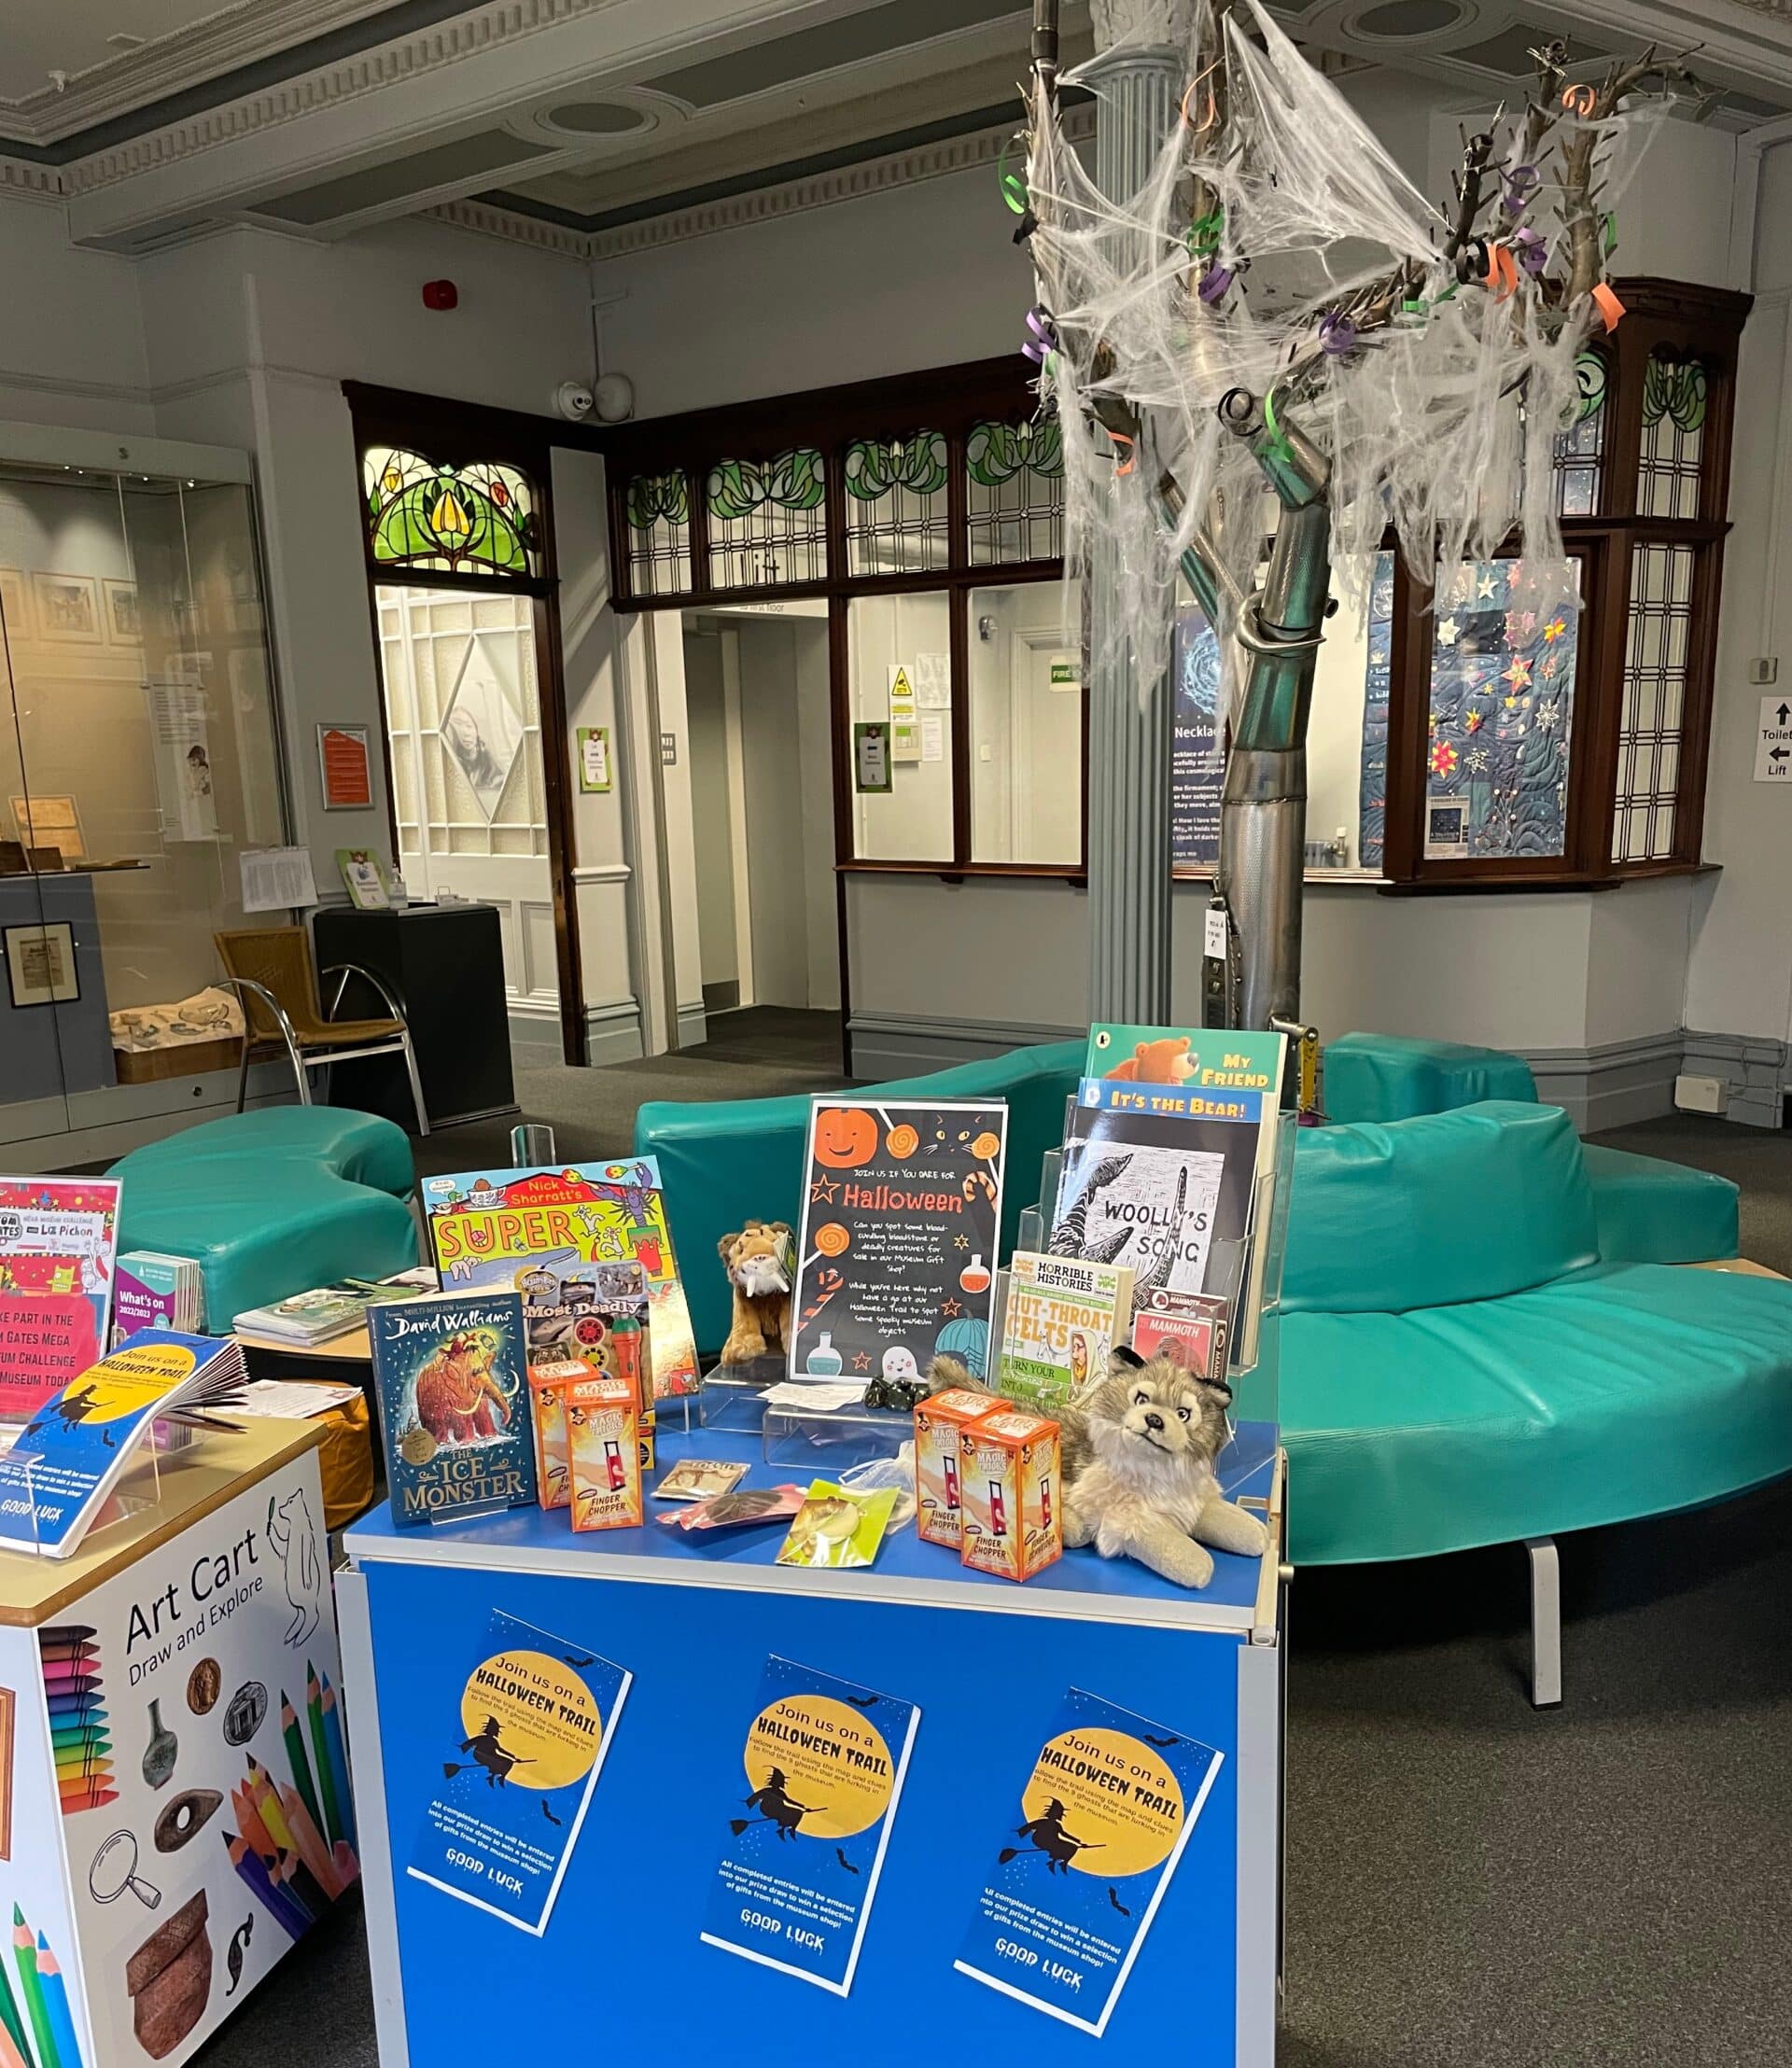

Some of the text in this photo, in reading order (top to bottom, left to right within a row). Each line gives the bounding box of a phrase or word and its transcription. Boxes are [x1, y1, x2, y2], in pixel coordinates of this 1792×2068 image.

[1052, 670, 1071, 678] FIRE
[1768, 764, 1786, 776] Lift
[1201, 1069, 1268, 1088] FRIEND
[1189, 1098, 1246, 1119] BEAR!
[854, 1168, 875, 1177] JOIN
[919, 1170, 939, 1179] DARE
[941, 1171, 956, 1180] FOR
[528, 1181, 560, 1192] Nick
[511, 1189, 582, 1205] Sharratt's
[844, 1183, 962, 1213] Halloween
[1105, 1200, 1208, 1232] WOOLLY'S
[60, 1224, 93, 1237] Pichon
[439, 1210, 579, 1258] SUPER
[871, 1223, 883, 1231] you
[886, 1223, 901, 1231] spot
[858, 1233, 886, 1244] curdling
[889, 1233, 928, 1241] bloodstone
[861, 1243, 941, 1252] deadly creatures for
[1137, 1236, 1199, 1263] SONG
[895, 1254, 924, 1263] Museum
[926, 1255, 945, 1264] Gift
[1039, 1262, 1093, 1281] HORRIBLE
[848, 1281, 867, 1290] While
[870, 1284, 890, 1292] you're
[913, 1285, 927, 1295] why
[1037, 1272, 1093, 1292] HISTORIES
[119, 1291, 165, 1309] What's on
[526, 1305, 573, 1319] Most
[575, 1298, 642, 1317] Deadly
[890, 1295, 900, 1306] go
[1169, 1295, 1201, 1306] MAMMOTH
[850, 1303, 886, 1312] Halloween
[889, 1305, 907, 1313] Trail
[922, 1306, 939, 1316] spot
[1008, 1293, 1113, 1333] CUT-THROAT
[13, 1312, 39, 1324] PART
[42, 1313, 51, 1325] IN
[55, 1314, 74, 1326] THE
[385, 1309, 513, 1340] David Walliams
[876, 1315, 900, 1326] spooky
[878, 1326, 906, 1337] objects
[1006, 1314, 1069, 1348] CELTS
[1149, 1319, 1199, 1337] MAMMOTH
[7, 1331, 70, 1347] GATES MEGA
[19, 1352, 77, 1367] CHALLENGE
[122, 1350, 147, 1360] Join
[98, 1359, 159, 1375] HALLOWEEN
[157, 1367, 188, 1379] TRAIL
[1030, 1363, 1056, 1378] YOUR
[0, 1371, 41, 1386] MUSEUM
[45, 1375, 75, 1388] TODA
[589, 1411, 623, 1430] MAGIC
[932, 1428, 959, 1439] MAGIC
[451, 1448, 472, 1460] THE
[977, 1452, 1007, 1462] MAGIC
[441, 1457, 486, 1484] ICE
[403, 1471, 527, 1512] MONSTER
[592, 1494, 621, 1506] FINGER
[1, 1499, 64, 1521] GOOD LUCK
[588, 1502, 626, 1516] CHOPPER
[931, 1510, 956, 1522] FINGER
[930, 1519, 960, 1530] CHOPPER
[976, 1536, 1001, 1548] FINGER
[973, 1545, 1007, 1559] CHOPPER
[127, 1529, 259, 1656] Art Cart
[129, 1577, 263, 1687] Draw and Explore
[496, 1656, 585, 1707] Join us on a
[476, 1668, 596, 1737] HALLOWEEN TRAIL
[776, 1703, 874, 1747] Join us on a
[758, 1716, 887, 1777] HALLOWEEN TRAIL
[1064, 1735, 1166, 1789] Join us on a
[1041, 1747, 1178, 1820] HALLOWEEN TRAIL
[446, 1848, 524, 1896] GOOD LUCK
[721, 1860, 856, 1913] All completed entries will be entered
[740, 1908, 825, 1952] GOOD LUCK
[995, 1937, 1083, 1990] GOOD LUCK
